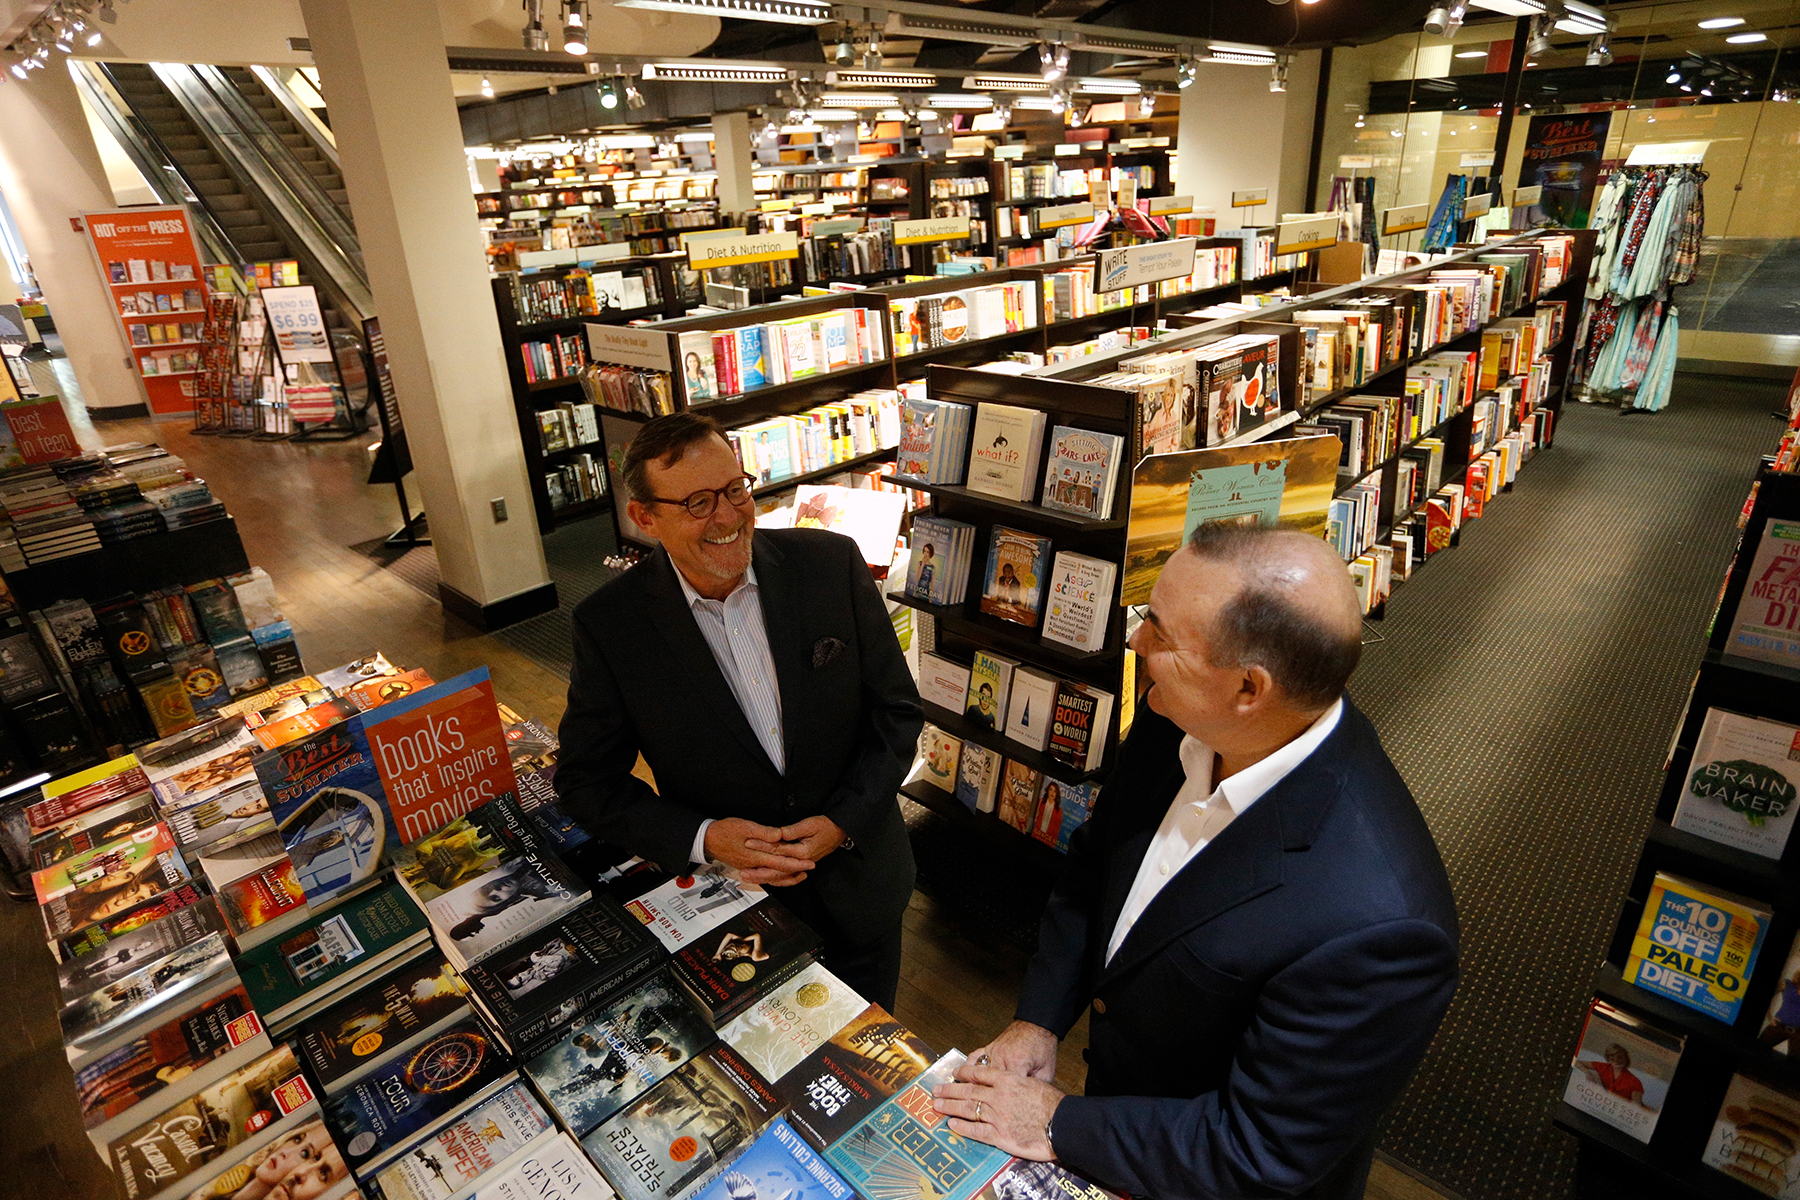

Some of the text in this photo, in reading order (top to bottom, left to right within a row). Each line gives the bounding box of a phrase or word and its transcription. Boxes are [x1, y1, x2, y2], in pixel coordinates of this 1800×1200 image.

[1541, 120, 1595, 142] Best
[93, 223, 117, 238] HOT
[148, 219, 184, 235] PRESS
[905, 227, 921, 237] Diet
[929, 224, 959, 235] Nutrition
[1298, 228, 1320, 243] Cooking
[707, 242, 782, 259] Diet & Nutrition
[1104, 249, 1128, 275] WRITE
[1107, 272, 1127, 290] STUFF
[274, 313, 318, 329] $6.99
[8, 409, 47, 436] best
[18, 430, 72, 459] in teen
[900, 437, 932, 453] Online
[977, 446, 1019, 463] what if?
[1060, 447, 1100, 462] BARS CAKE
[1071, 439, 1096, 451] SITTING
[1000, 549, 1034, 567] AWESOME
[1055, 583, 1096, 603] SCIENCE
[67, 641, 102, 657] ELLEN
[1055, 706, 1091, 730] BOOK
[1057, 694, 1093, 713] SMARTEST
[303, 741, 316, 753] the
[375, 714, 465, 780] books
[1063, 725, 1088, 742] WORLD
[277, 734, 350, 782] Best
[276, 751, 365, 804] SUMMER
[392, 745, 498, 807] that inspire
[1705, 763, 1787, 796] BRAIN
[495, 798, 519, 830] Bones
[1062, 788, 1087, 807] GUIDE
[1692, 782, 1785, 817] MAKER
[1683, 812, 1708, 824] DAVID
[159, 861, 181, 885] GREEN
[261, 867, 295, 908] ALLEGIANT
[525, 852, 572, 900] CAPTIVE
[372, 895, 400, 935] TOMATOES
[393, 905, 412, 928] GREEN
[581, 897, 634, 959] SNIPER
[645, 908, 683, 948] TOM ROB SMITH
[667, 903, 694, 931] CHILD
[1658, 913, 1721, 945] POUNDS
[1664, 899, 1728, 932] THE 10
[474, 932, 523, 963] CAPTIVE
[566, 906, 616, 966] AMERICAN
[1652, 925, 1719, 960] OFF
[678, 948, 730, 1000] DARK PLACES
[1646, 943, 1740, 993] PALEO
[1725, 950, 1744, 965] 100
[472, 965, 497, 992] KYLE
[711, 965, 734, 988] GILLIAN
[1639, 963, 1704, 999] DIET
[381, 983, 399, 1000] THE
[393, 1003, 419, 1031] WAVE
[518, 958, 650, 1038] CHRIS AMERICAN SNIPER
[203, 1012, 226, 1040] SPARKS
[231, 1017, 252, 1041] FREE
[523, 1026, 546, 1043] KYLE
[756, 1001, 815, 1055] THE GIVER
[766, 993, 825, 1047] LOIS LOWRY
[593, 1013, 655, 1085] INSURGENT
[717, 1046, 776, 1105] JAMES DASHNER
[814, 1069, 854, 1106] THIEF
[820, 1054, 871, 1100] MARKUS ZUSAK
[279, 1082, 303, 1109] FREE
[379, 1073, 413, 1113] FOUR
[800, 1078, 842, 1117] BOOK
[808, 1100, 819, 1110] THE
[897, 1084, 941, 1127] PAN
[1576, 1083, 1649, 1126] GODDESSES
[1580, 1094, 1616, 1113] NEVER
[352, 1084, 377, 1117] VERONICA
[368, 1117, 385, 1137] ROTH
[496, 1094, 532, 1141] CHRIS KYLE
[508, 1092, 538, 1130] NAVY SEAL
[127, 1121, 181, 1186] Vacancy
[159, 1108, 215, 1167] Casual
[454, 1119, 494, 1171] AMERICAN
[620, 1126, 665, 1182] TRIALS
[889, 1119, 969, 1189] PETER
[436, 1127, 479, 1182] SNIPER
[606, 1130, 660, 1193] SCORCH
[770, 1122, 848, 1199] SUZANNE COLLINS
[118, 1160, 143, 1197] ROWLING
[407, 1170, 421, 1189] LETHAL
[552, 1159, 582, 1195] LISA
[1005, 1168, 1042, 1200] SPARKS
